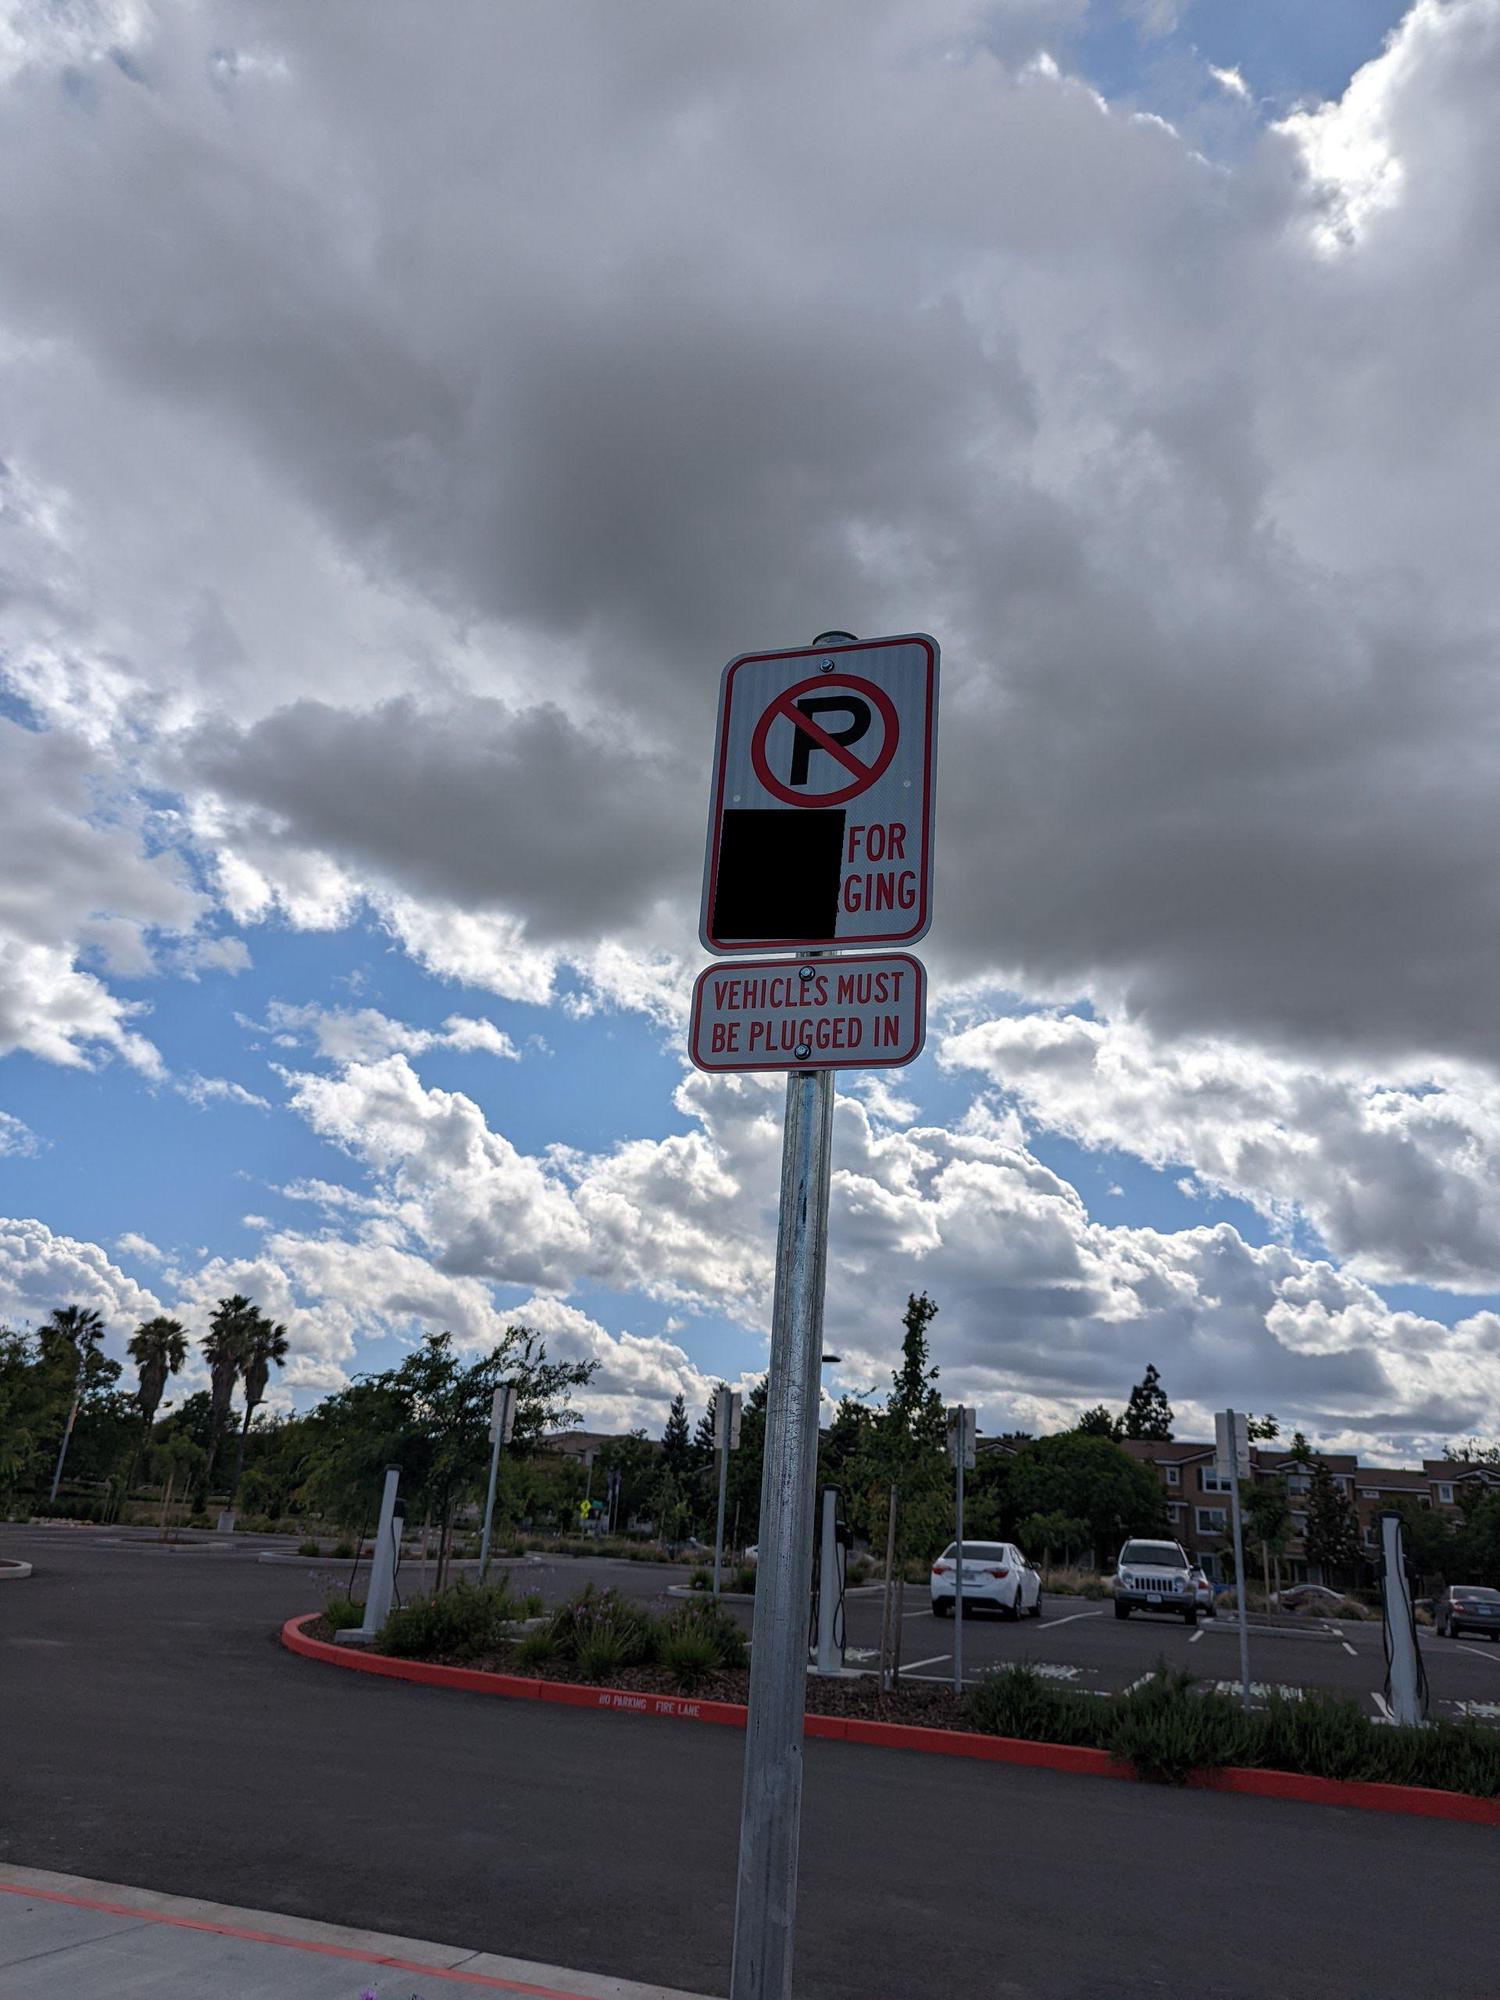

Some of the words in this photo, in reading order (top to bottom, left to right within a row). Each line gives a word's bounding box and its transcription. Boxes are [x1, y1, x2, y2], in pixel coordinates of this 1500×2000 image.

[790, 695, 872, 786] P
[848, 823, 907, 863] FOR
[837, 870, 917, 913] GING
[714, 975, 829, 1011] VEHICLES
[837, 971, 904, 1005] MUST
[711, 1022, 741, 1053] BE
[749, 1017, 863, 1052] PLUGGED
[873, 1015, 900, 1048] IN
[599, 1694, 611, 1704] NO
[613, 1695, 647, 1710] PARKING
[655, 1701, 675, 1714] FIRE
[677, 1703, 701, 1717] LANE
